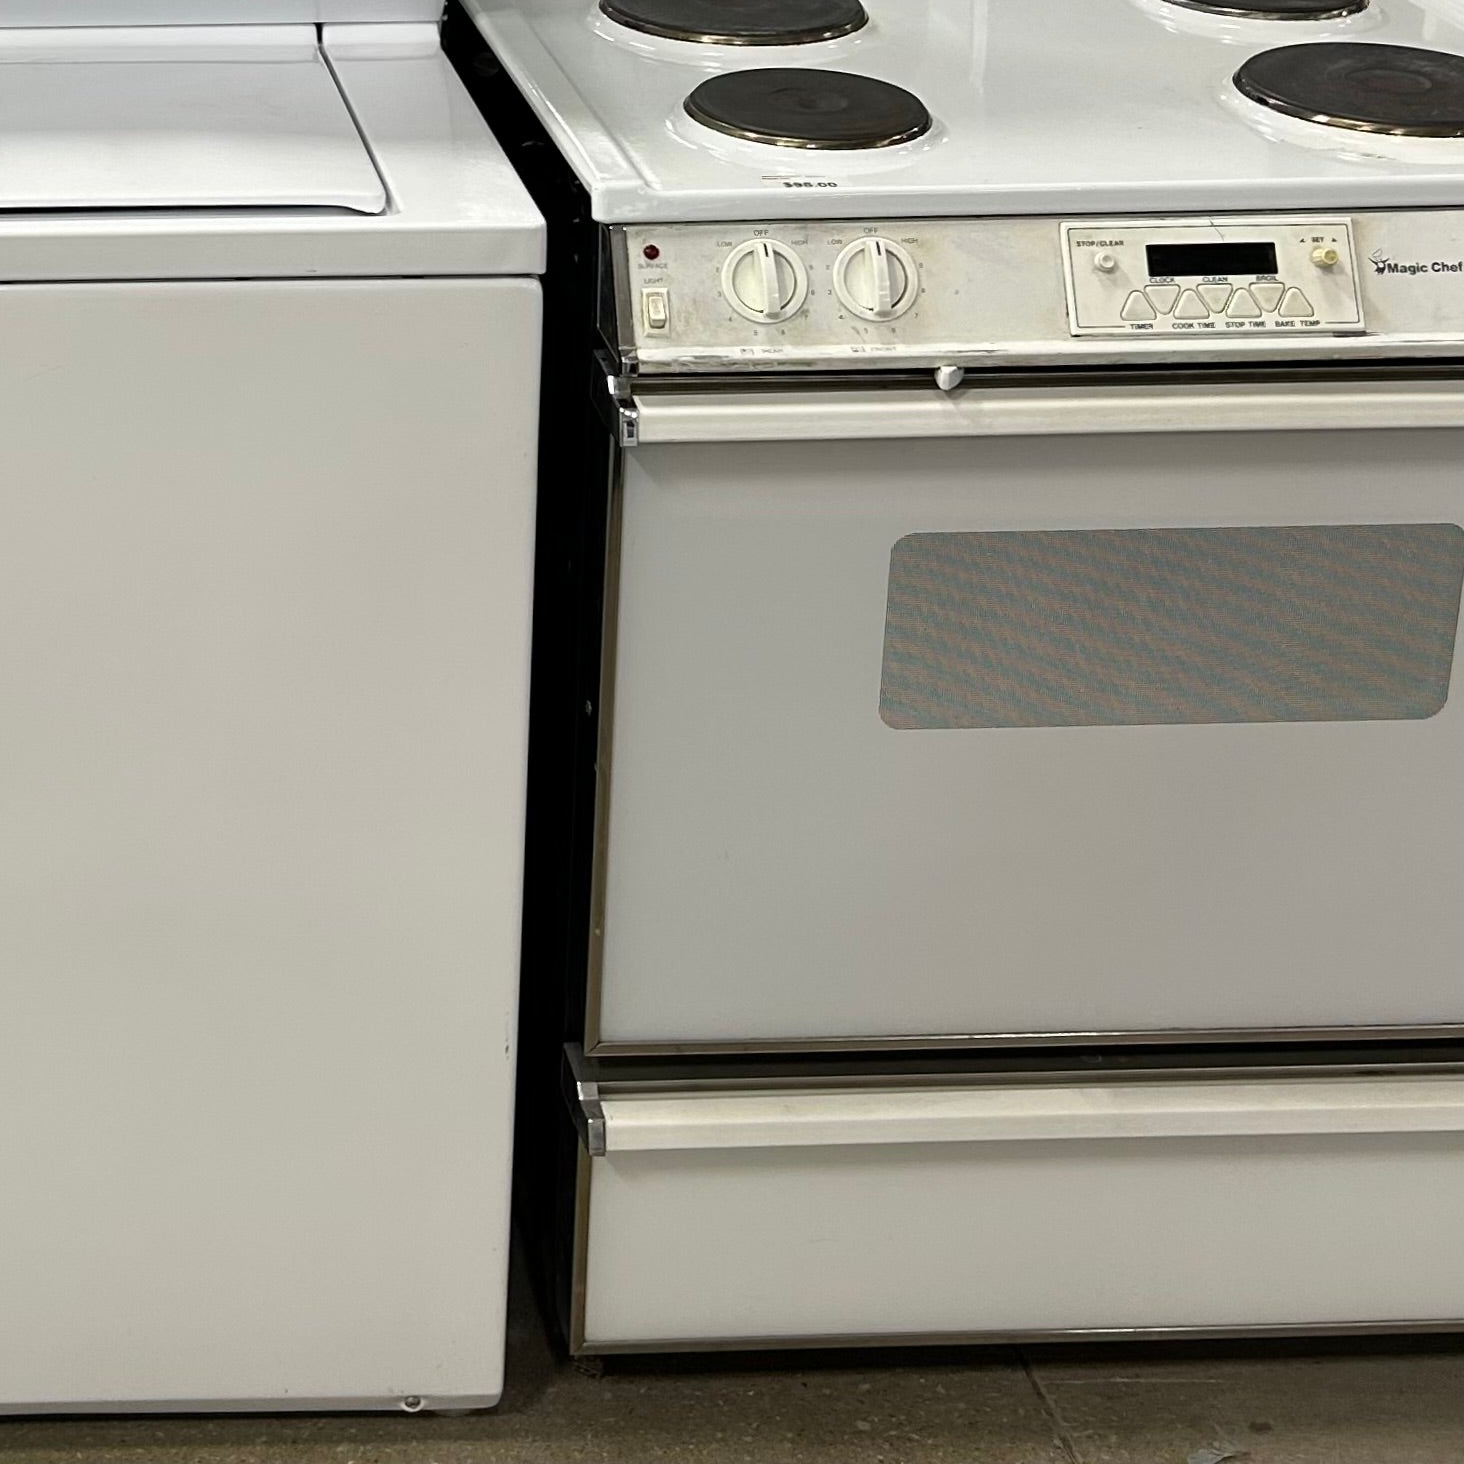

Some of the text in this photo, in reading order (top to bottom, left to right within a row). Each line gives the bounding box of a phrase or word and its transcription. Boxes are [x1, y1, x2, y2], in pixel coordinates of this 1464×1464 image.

[753, 229, 769, 237] OFF
[716, 241, 733, 249] LOW
[1075, 240, 1125, 248] STOP/CLEAR
[637, 262, 668, 270] SURFACE
[1386, 261, 1463, 276] Magic Chef
[1256, 274, 1278, 282] BROIL
[1172, 321, 1216, 330] COOK TIME
[1247, 320, 1267, 328] TIME
[1299, 319, 1321, 327] TEMP
